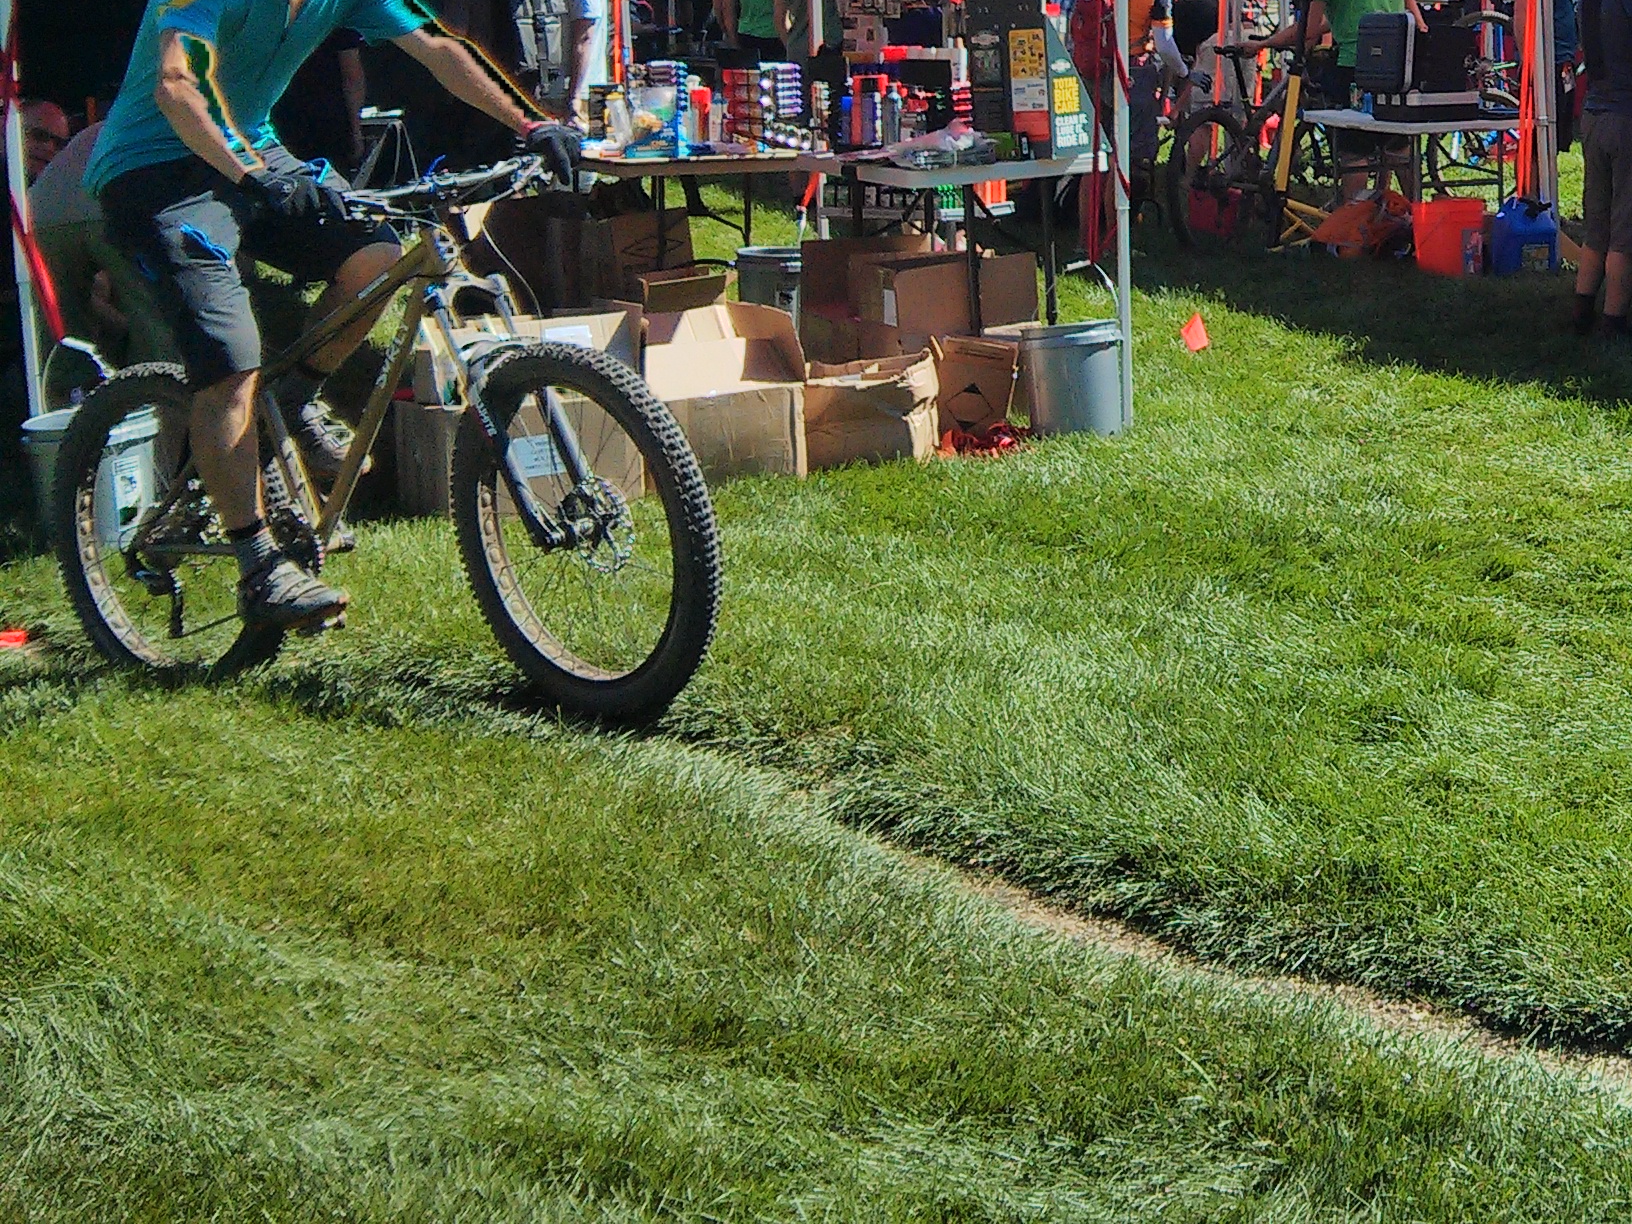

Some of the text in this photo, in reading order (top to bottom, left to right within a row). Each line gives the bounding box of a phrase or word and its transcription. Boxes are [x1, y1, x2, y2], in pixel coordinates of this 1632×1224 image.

[1053, 76, 1079, 90] TOTAL
[1053, 88, 1080, 103] BIKE
[1054, 101, 1080, 115] CARE
